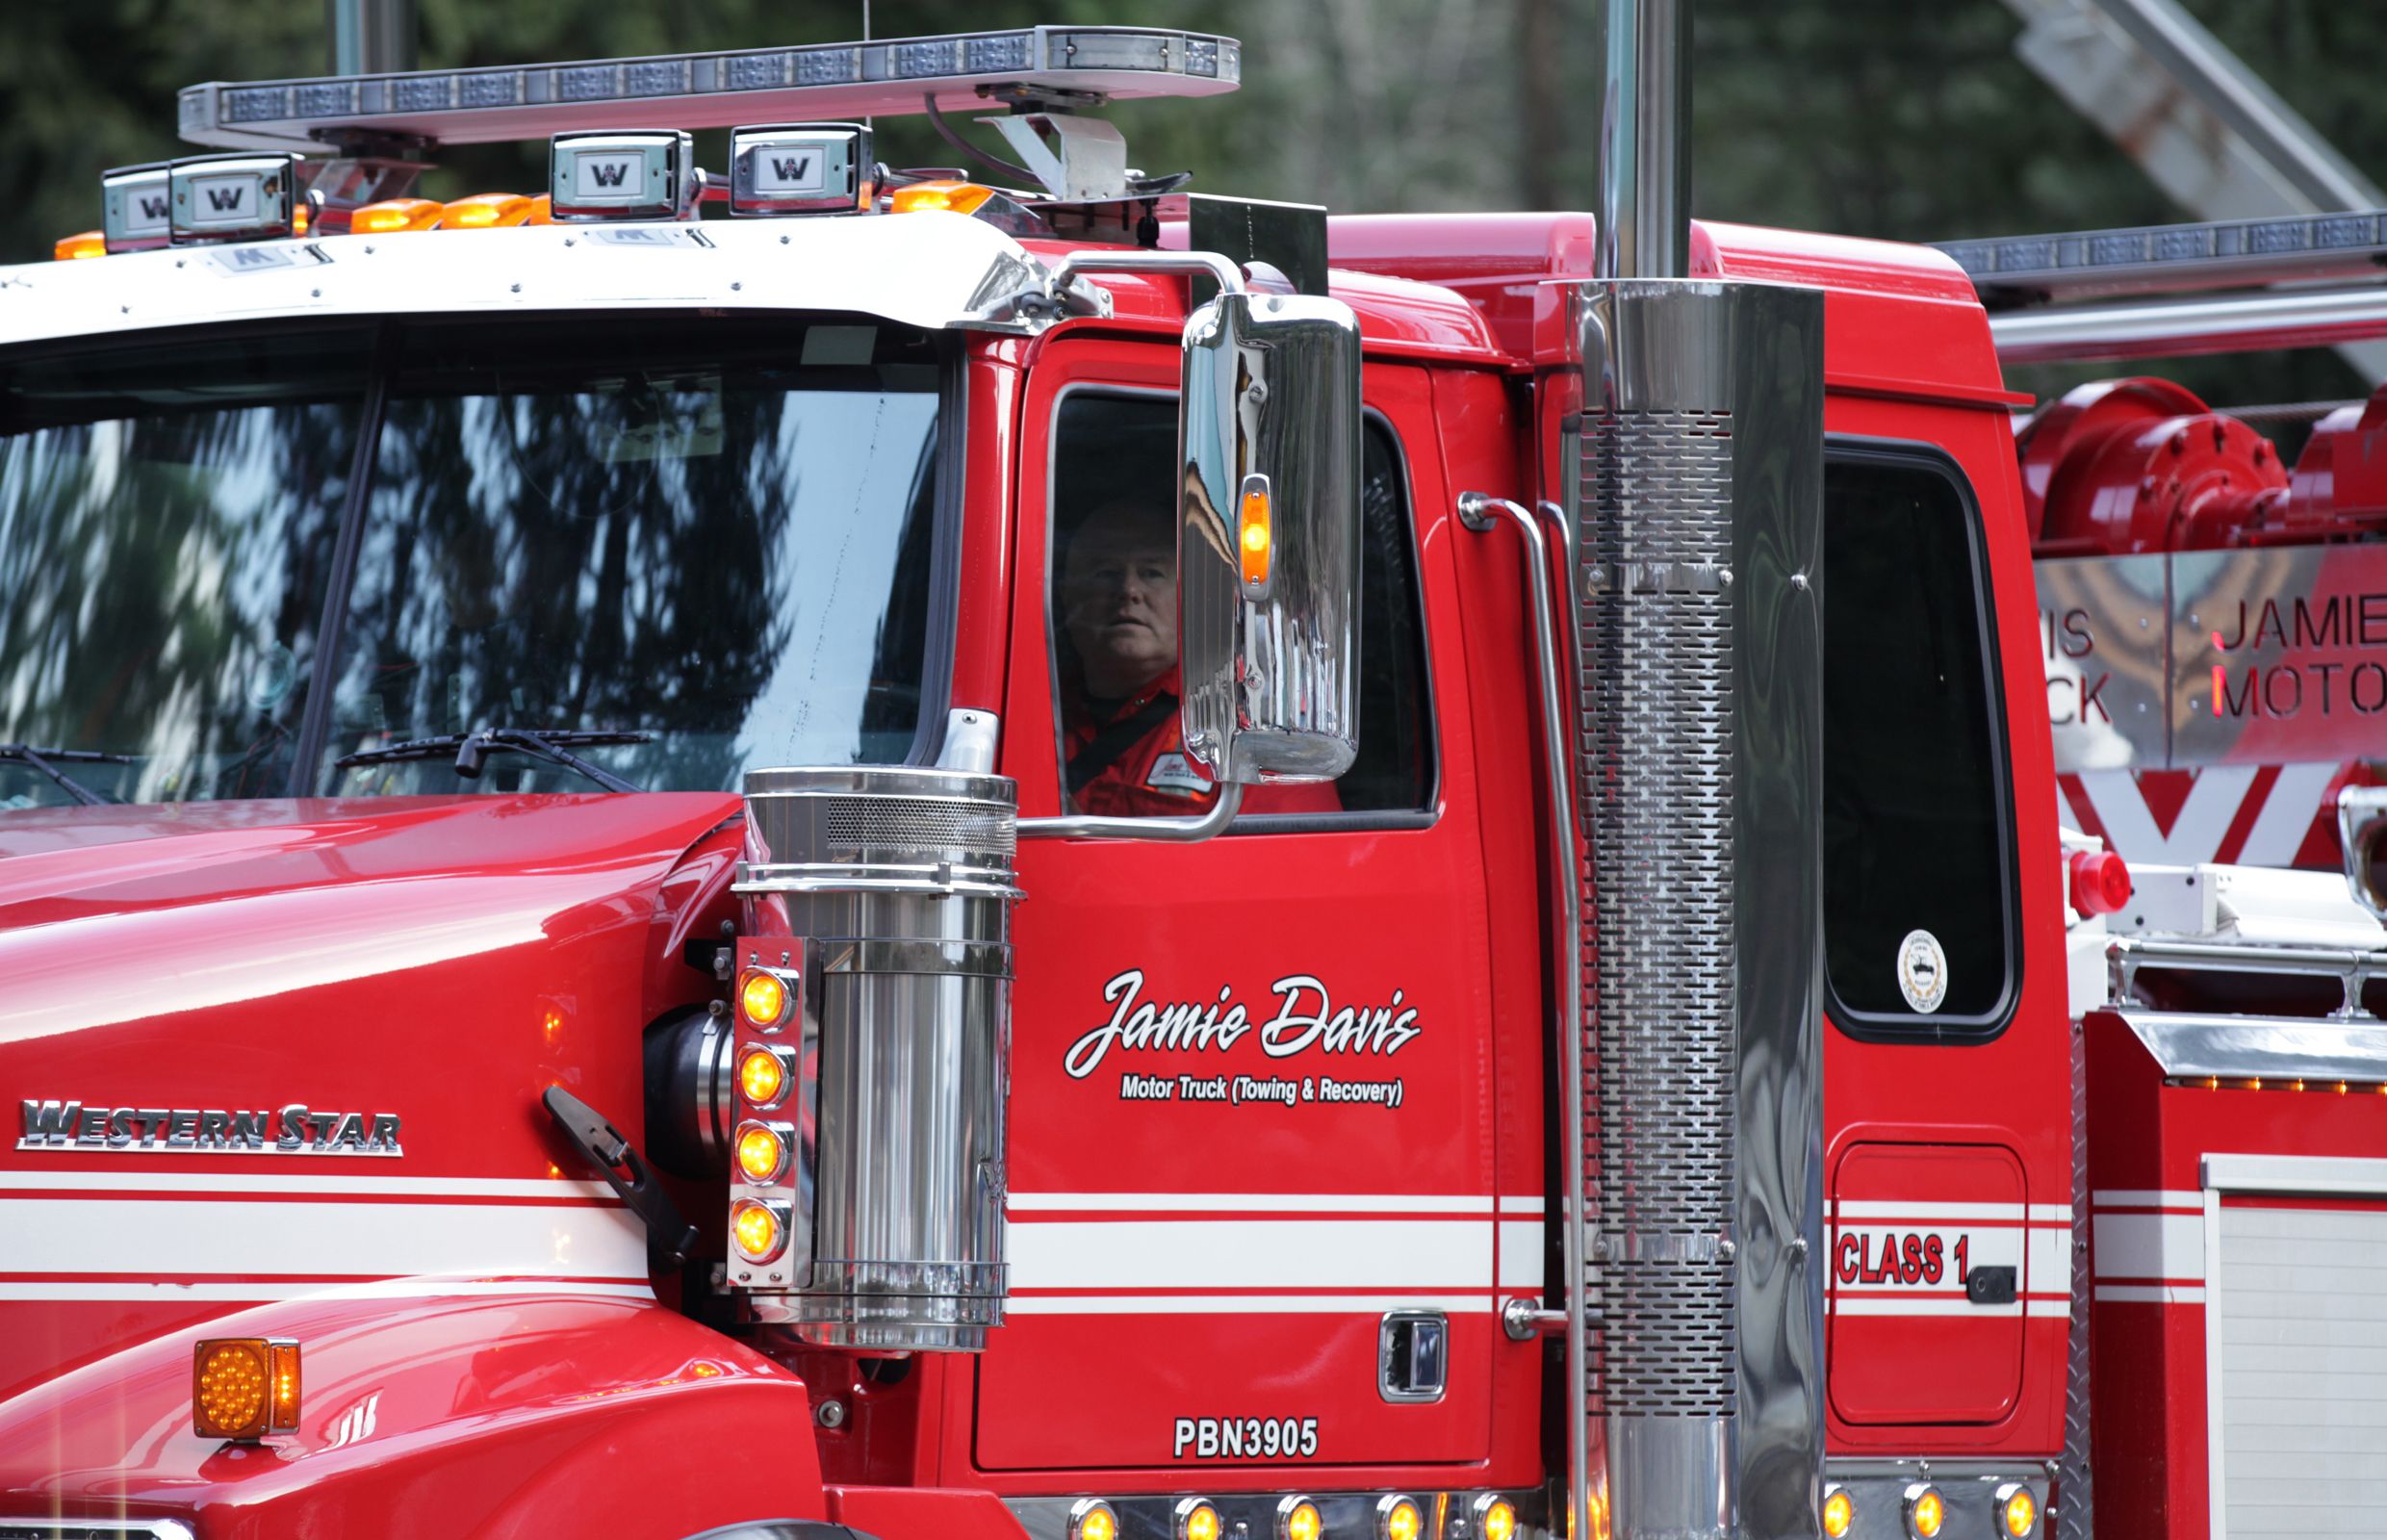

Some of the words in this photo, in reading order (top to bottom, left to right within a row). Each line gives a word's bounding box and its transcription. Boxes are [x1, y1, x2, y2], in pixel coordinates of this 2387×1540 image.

[2039, 608, 2093, 659] IS
[2211, 594, 2387, 652] JAMIE
[2212, 662, 2387, 717] MOTO
[1064, 968, 1251, 1079] Jamie
[1260, 974, 1422, 1058] Davis
[1119, 1073, 1174, 1100] Motor
[1178, 1075, 1227, 1101] Truck
[1230, 1076, 1297, 1106] (Towing
[1300, 1077, 1316, 1102] &
[1319, 1078, 1404, 1108] Recovery)
[21, 1099, 270, 1149] WESTERN
[276, 1104, 402, 1152] STAR
[1837, 1232, 1944, 1285] CLASS
[1954, 1234, 1969, 1285] 1
[1173, 1417, 1319, 1458] PBN3905
